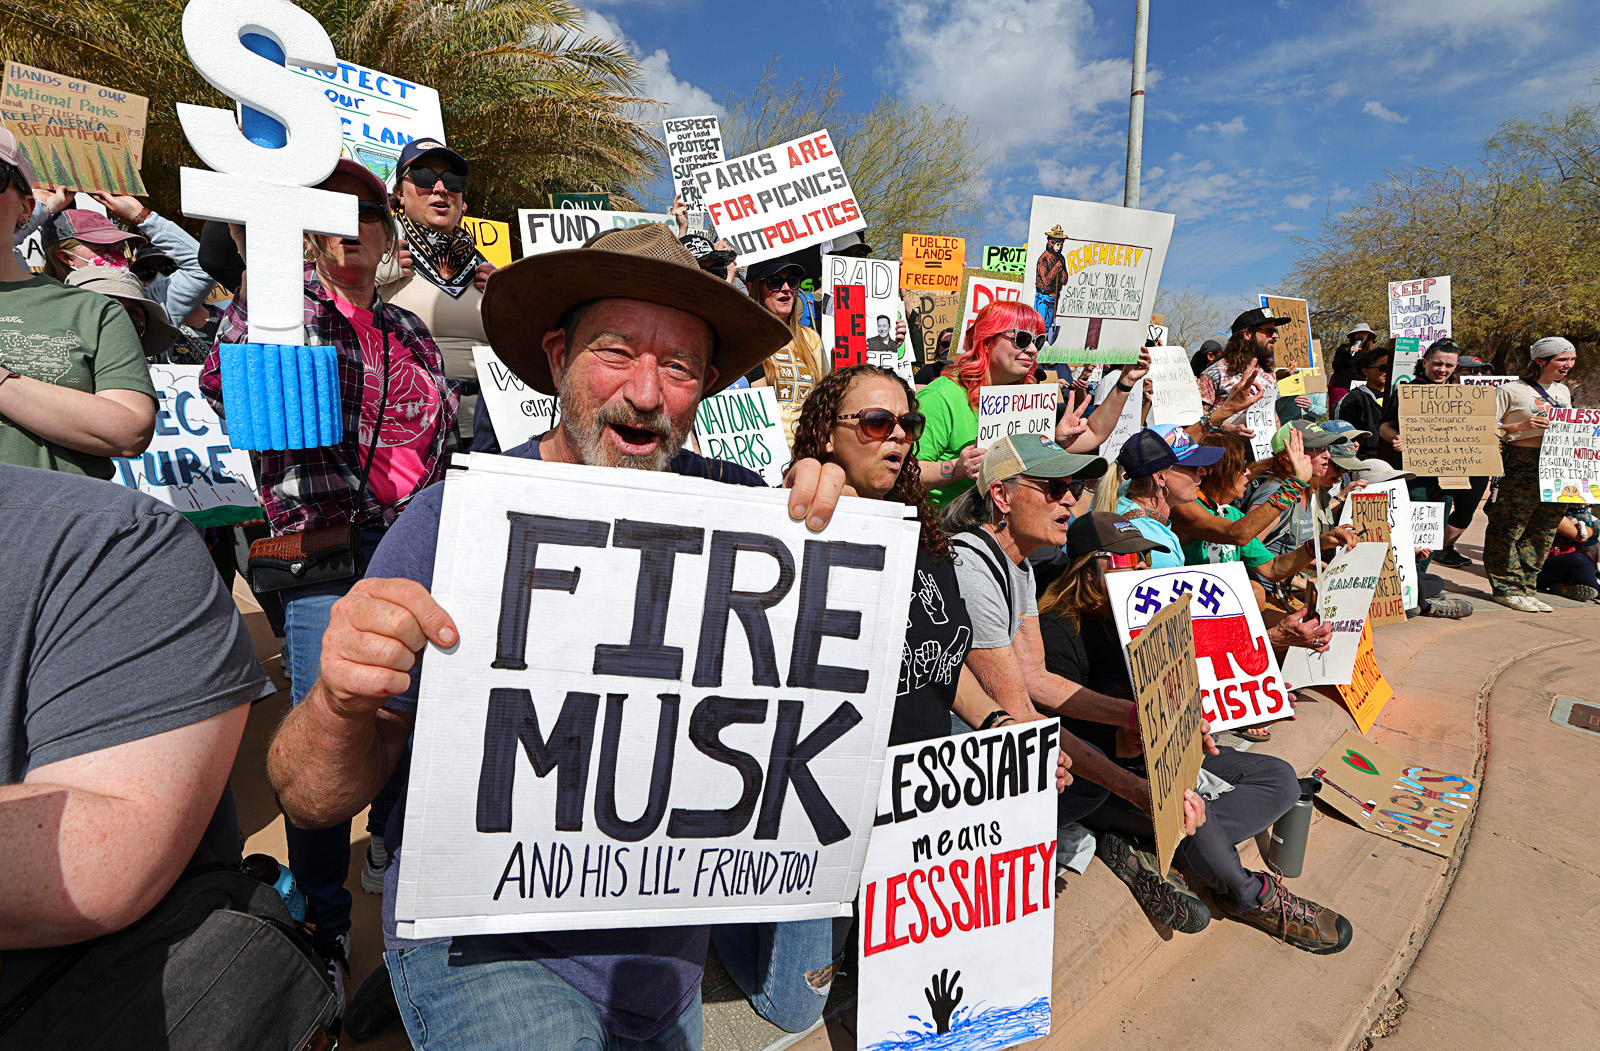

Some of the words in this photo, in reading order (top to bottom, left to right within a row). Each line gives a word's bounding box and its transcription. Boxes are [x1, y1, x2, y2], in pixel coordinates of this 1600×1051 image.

[10, 65, 61, 86] HANDS
[69, 82, 91, 94] OFF
[98, 89, 127, 104] OUR
[2, 99, 23, 109] and
[6, 83, 71, 109] National
[80, 99, 119, 118] Parks
[324, 89, 365, 109] our
[1, 111, 42, 122] KEEP
[48, 116, 109, 132] AMERICA
[666, 117, 716, 134] RESPECT
[17, 122, 121, 145] BEAUTIFUL!
[363, 122, 414, 147] LAN
[677, 132, 692, 140] our
[693, 129, 711, 139] land
[669, 138, 720, 156] PROTECT
[679, 155, 693, 164] our
[694, 151, 718, 164] parks
[696, 152, 777, 194] PARKS
[787, 134, 833, 169] ARE
[708, 194, 758, 226] FOR
[757, 167, 847, 213] PICNICS
[527, 213, 600, 243] FUND
[723, 228, 766, 256] NOT
[763, 198, 860, 249] POLITICS
[911, 236, 959, 249] PUBLIC
[915, 248, 952, 261] LANDS
[1067, 243, 1143, 276] REMEMBER!
[830, 257, 893, 299] BAD
[906, 273, 959, 287] FREEDOM
[1078, 272, 1100, 286] ONLY
[1105, 273, 1117, 287] YOU
[1120, 275, 1136, 288] CAN
[1066, 287, 1085, 299] SAVE
[1090, 288, 1119, 301] NATIONAL
[1124, 289, 1141, 303] PARKS
[1390, 279, 1436, 299] KEEP
[1067, 300, 1084, 313] PARK
[1087, 301, 1116, 315] RANGERS
[1391, 295, 1440, 314] Public
[1391, 307, 1445, 330] Land
[1285, 333, 1299, 350] FOR
[1403, 386, 1462, 399] EFFECTS
[1472, 387, 1488, 399] OF
[695, 391, 776, 436] NATIONAL
[980, 394, 1010, 416] KEEP
[1012, 392, 1057, 413] POLITICS
[1421, 401, 1475, 414] LAYOFFS:
[1549, 408, 1600, 424] UNLESS
[980, 423, 1001, 441] OUT
[1007, 420, 1021, 436] OF
[1028, 418, 1051, 434] OUR
[1429, 424, 1458, 434] Rangers
[1574, 424, 1591, 434] LIKE
[708, 433, 772, 468] PARKS
[1454, 446, 1482, 454] risks
[1541, 446, 1559, 456] AWFUL
[1543, 435, 1562, 445] CARES
[1564, 436, 1570, 445] A
[1573, 437, 1597, 448] WHOLE
[112, 445, 236, 489] TURE
[1429, 457, 1439, 467] of
[1442, 456, 1483, 466] scientific
[1540, 458, 1547, 467] IS
[1548, 458, 1572, 468] GOING
[1573, 460, 1580, 469] TO
[1582, 461, 1597, 470] GET
[1540, 468, 1565, 479] BETTER
[1583, 470, 1599, 480] NOT
[1356, 501, 1388, 522] PROTECT
[1411, 506, 1424, 521] AVE
[1426, 505, 1439, 518] THE
[1412, 522, 1439, 533] ORKING
[1413, 533, 1435, 545] LASS!
[491, 511, 888, 694] FIRE
[1385, 598, 1403, 617] LATE
[1134, 623, 1168, 694] INJUSTICE
[1201, 676, 1284, 724] CISTS
[1145, 698, 1158, 748] IS
[1157, 688, 1168, 734] A
[475, 687, 864, 846] MUSK
[961, 722, 1060, 807] STAFF
[1154, 724, 1181, 811] JUSTICE
[1374, 766, 1476, 848] PARKS
[912, 820, 1002, 863] means
[493, 841, 573, 901] AND
[580, 845, 630, 899] HIS
[639, 848, 685, 898] LIL'
[693, 847, 779, 898] FRIEND
[778, 850, 819, 896] TOO!
[864, 866, 952, 958] LESS
[950, 840, 1058, 932] SAFTEY
